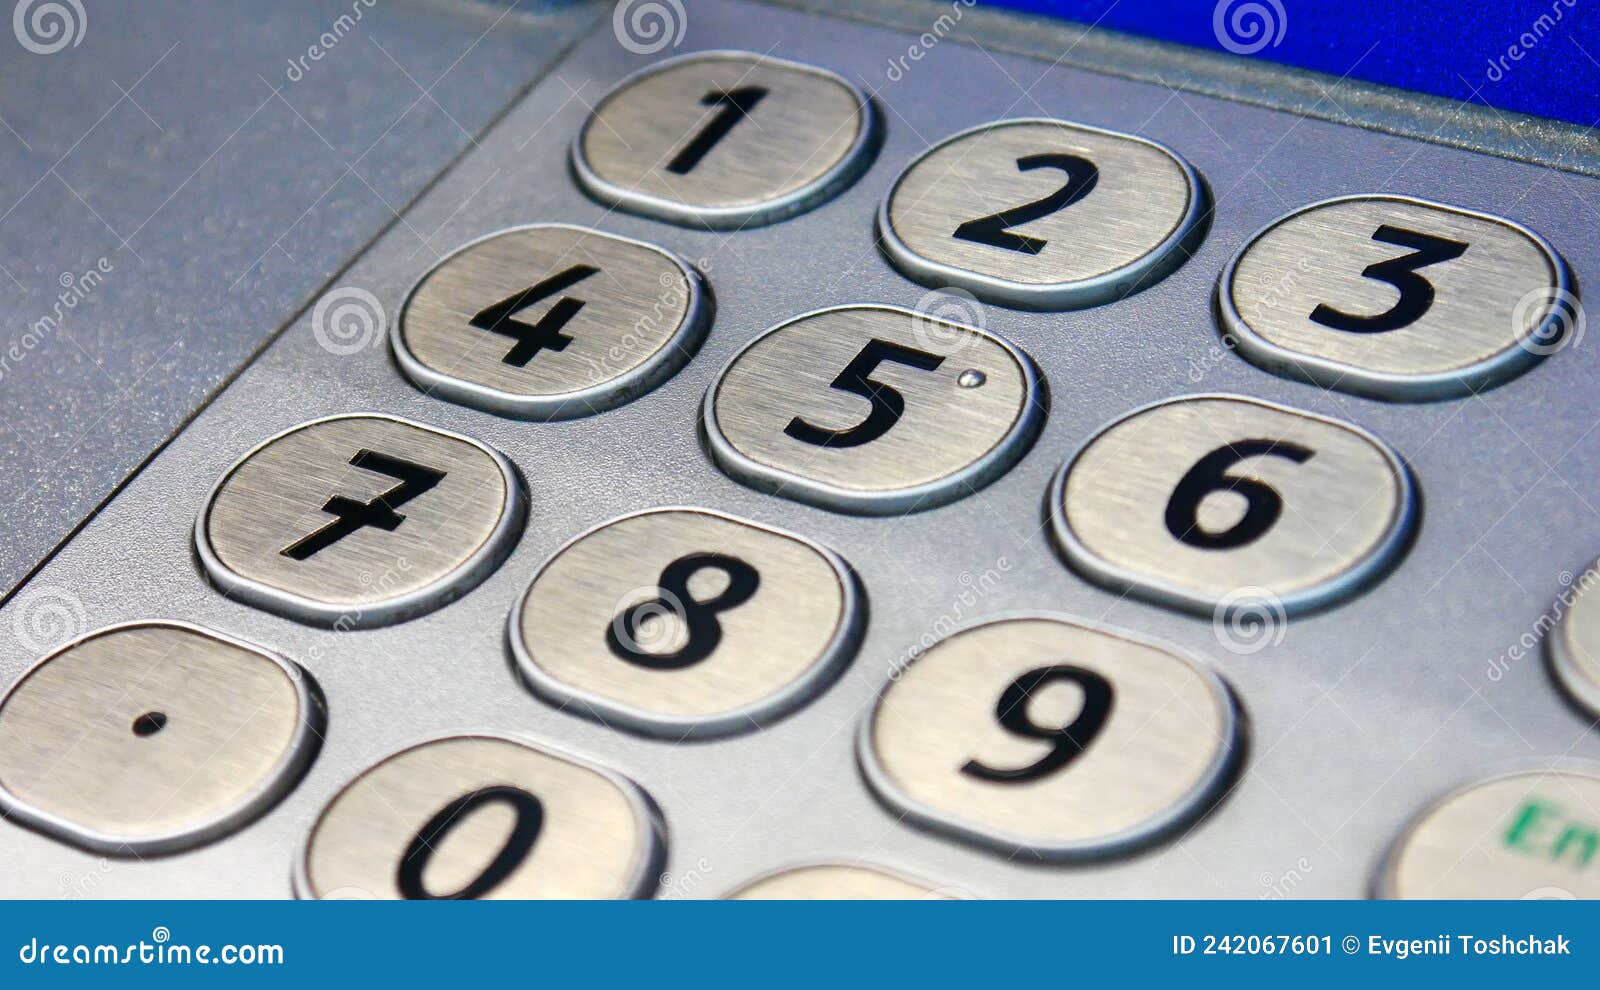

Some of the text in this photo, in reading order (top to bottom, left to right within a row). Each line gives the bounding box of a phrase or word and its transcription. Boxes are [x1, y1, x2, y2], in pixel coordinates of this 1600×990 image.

[666, 85, 769, 175] 1
[952, 153, 1099, 256] 2
[468, 264, 601, 368] 4
[1308, 224, 1470, 334] 3
[783, 338, 946, 449] 5
[279, 448, 448, 561] 7
[1164, 439, 1315, 550] 6
[606, 552, 760, 670] 8
[961, 665, 1114, 784] 9
[396, 785, 544, 900] 0
